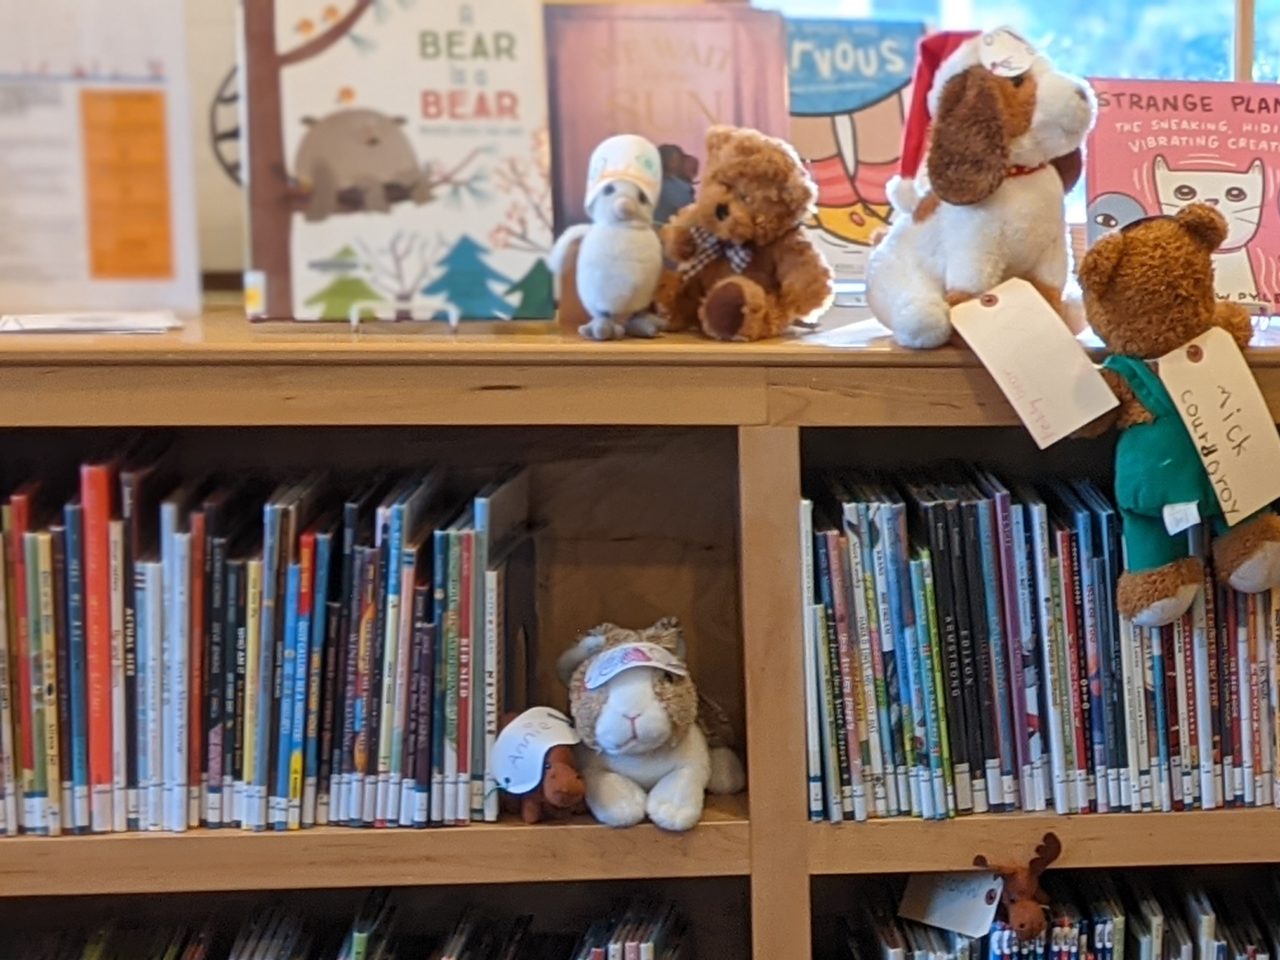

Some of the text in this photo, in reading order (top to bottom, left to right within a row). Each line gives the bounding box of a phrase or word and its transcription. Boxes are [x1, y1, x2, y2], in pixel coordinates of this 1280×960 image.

[419, 30, 518, 61] BEAR
[420, 89, 521, 121] BEAR
[1098, 91, 1214, 113] STRANGE
[1115, 121, 1142, 134] THE
[1128, 134, 1219, 154] VIBRATING
[125, 608, 134, 649] ACTUAL
[459, 638, 469, 697] RED SLED
[945, 616, 961, 697] ARMSTRONG
[961, 630, 974, 686] EDISON
[486, 670, 495, 735] NEVILLE
